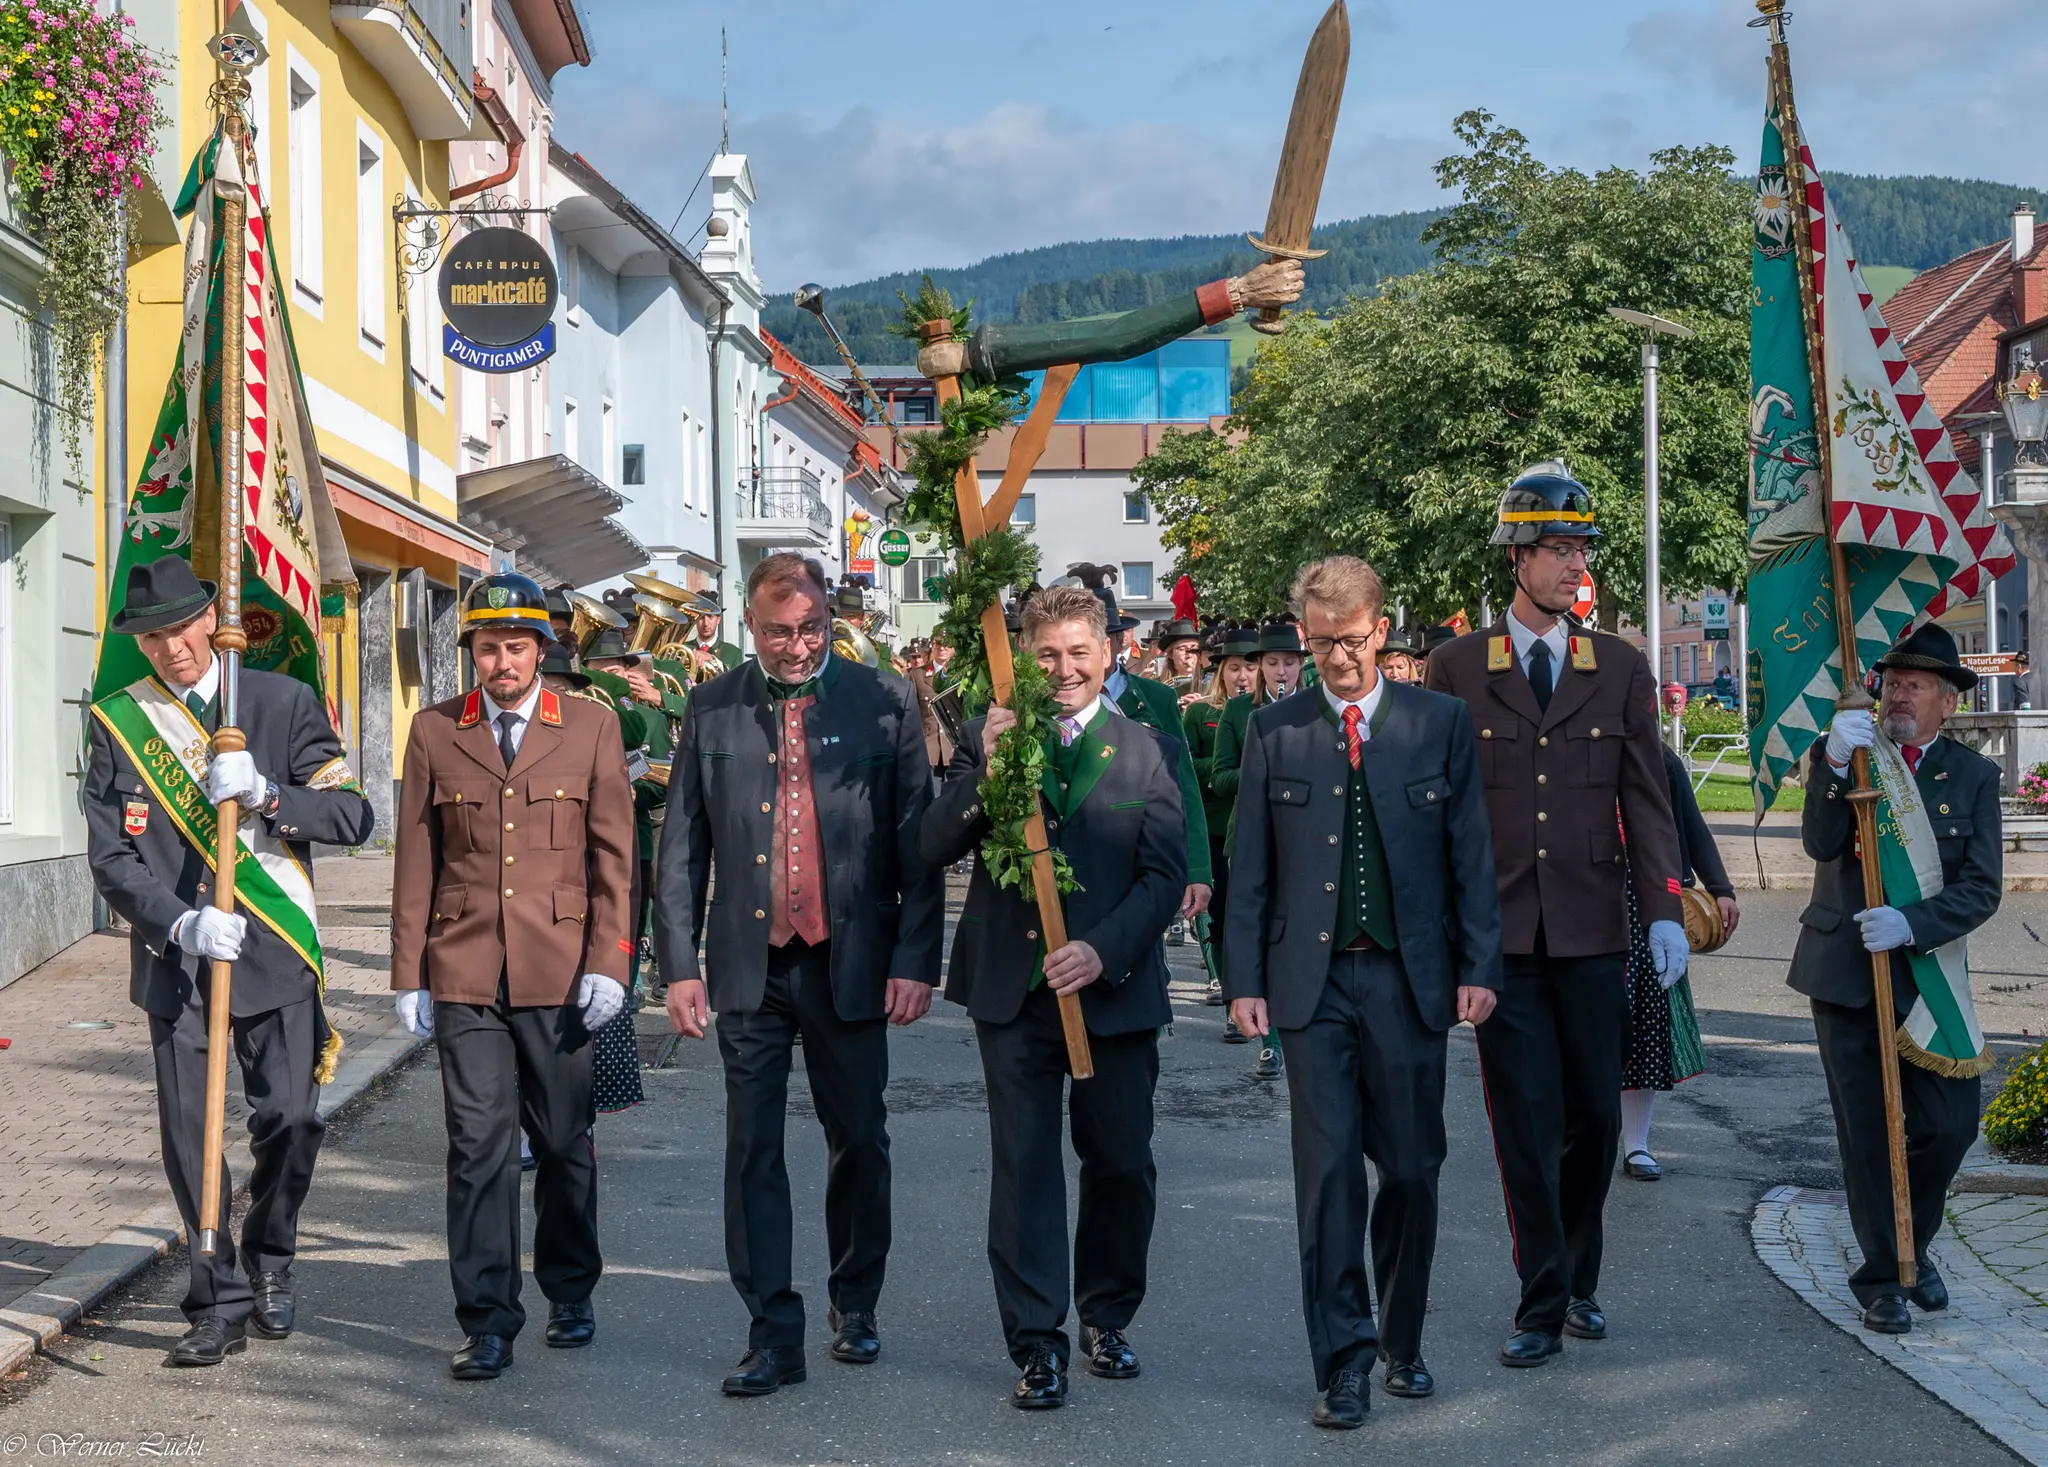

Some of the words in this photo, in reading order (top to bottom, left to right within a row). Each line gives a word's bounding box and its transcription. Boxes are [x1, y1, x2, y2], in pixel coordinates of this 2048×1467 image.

[511, 261, 540, 270] PUB
[449, 338, 546, 368] PUNTIGAMER
[880, 540, 910, 554] Gösser
[242, 616, 272, 634] 954
